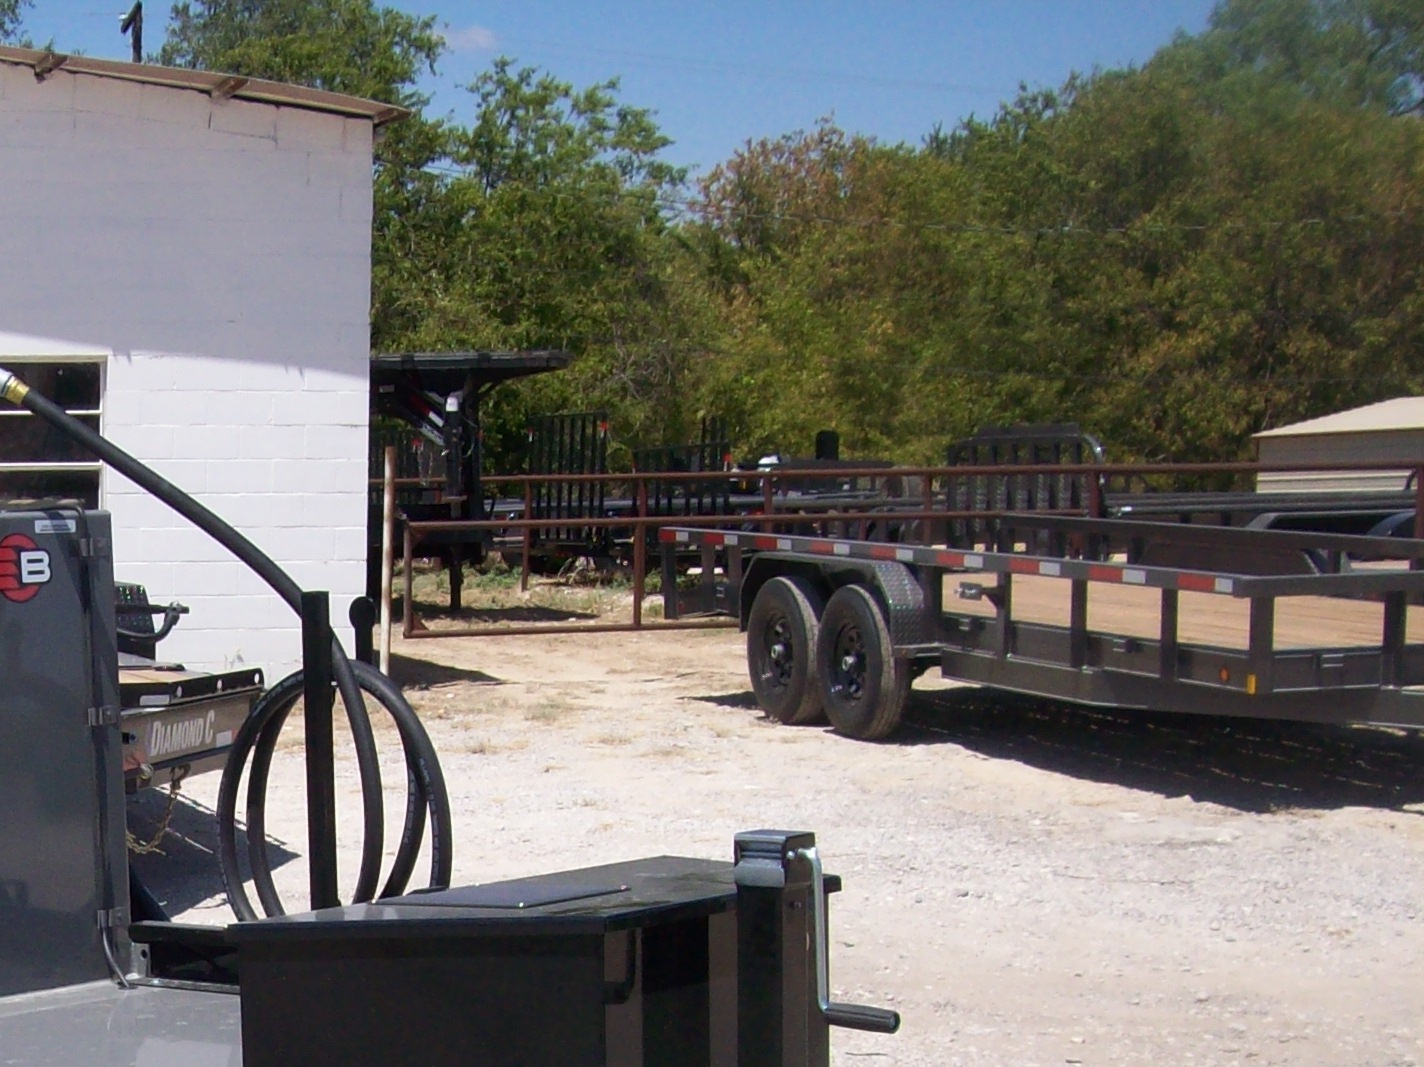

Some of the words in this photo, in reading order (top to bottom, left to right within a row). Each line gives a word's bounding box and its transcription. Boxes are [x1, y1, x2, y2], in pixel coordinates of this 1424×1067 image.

[20, 550, 51, 584] B
[150, 717, 204, 757] DIAMOND
[205, 709, 216, 744] C
